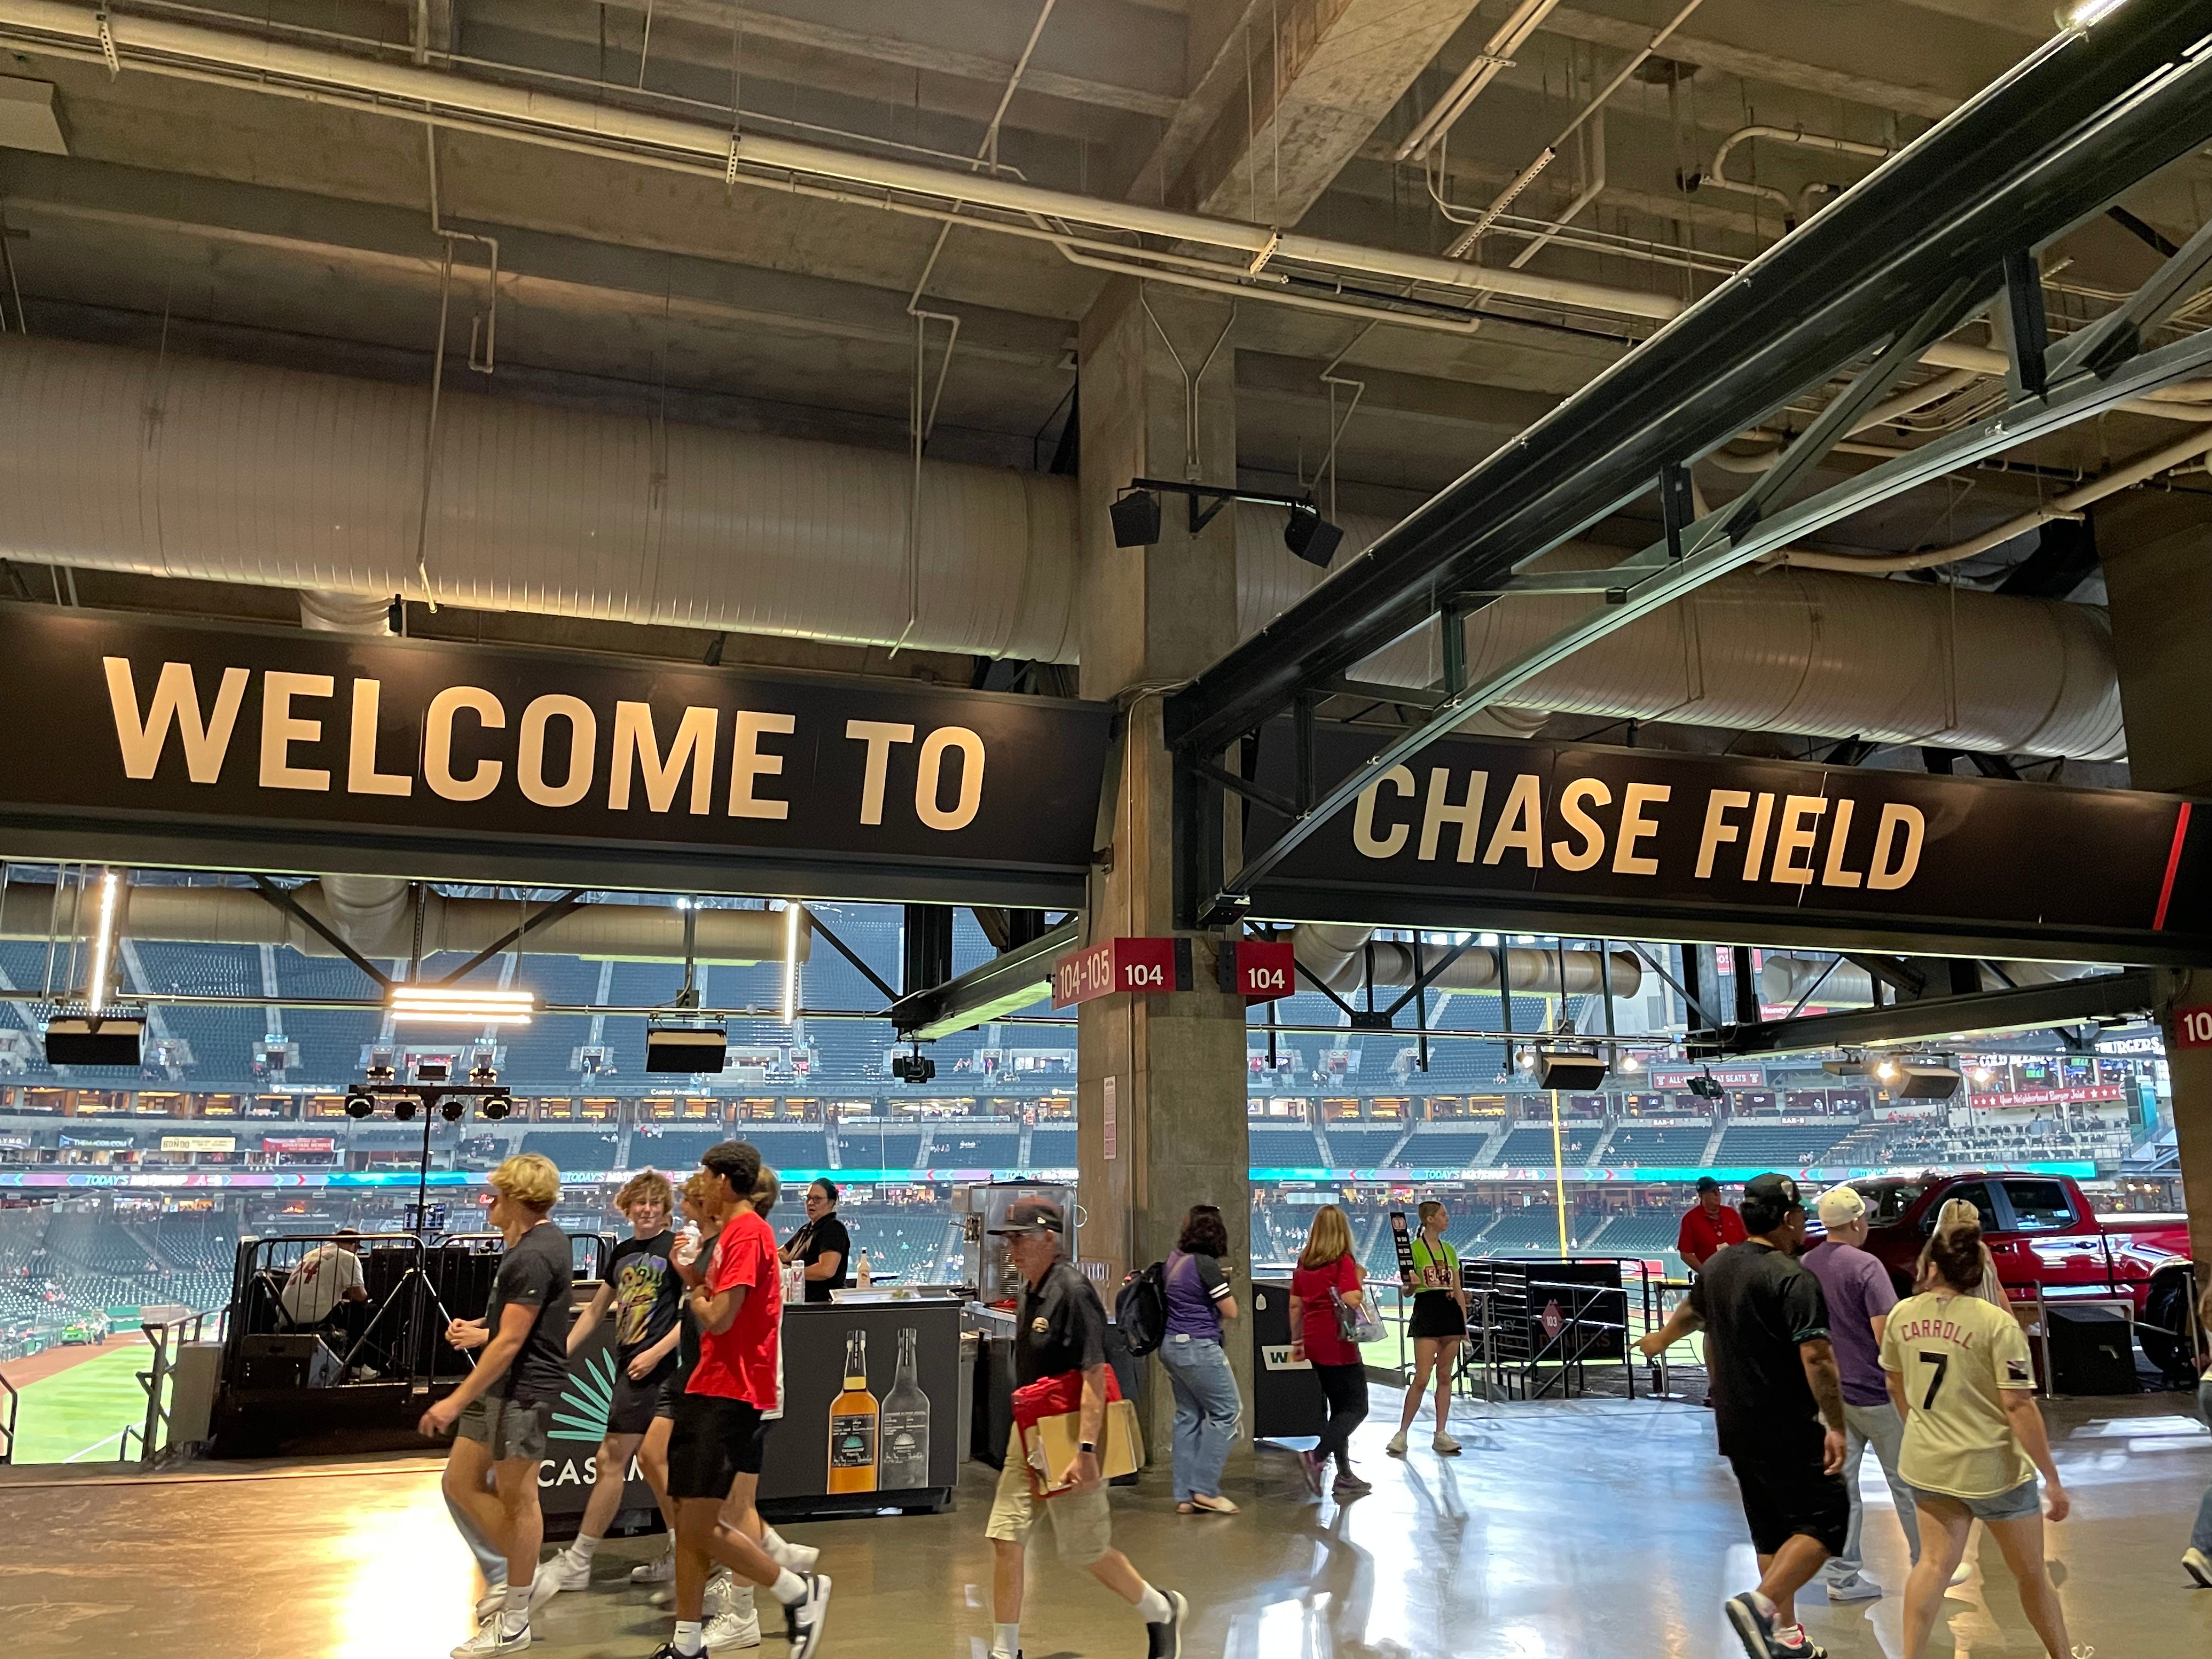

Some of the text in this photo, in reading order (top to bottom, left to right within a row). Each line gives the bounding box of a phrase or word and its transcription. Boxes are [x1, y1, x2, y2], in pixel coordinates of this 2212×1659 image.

[103, 657, 985, 831] WELCOME TO
[1353, 764, 1925, 890] CHASE FIELD
[1060, 949, 1109, 1000] 104-105
[1125, 964, 1164, 986] 104
[1248, 968, 1285, 989] 104
[2184, 1012, 2212, 1041] 10
[1725, 1074, 1746, 1082] SEATS
[85, 1174, 129, 1186] TODAY'S
[566, 1172, 606, 1183] TODAY'S
[1426, 1169, 1509, 1181] TODAY'S MATCHUP
[1546, 1316, 1558, 1327] 103
[1901, 1319, 1973, 1350] CARROLL
[1919, 1351, 1948, 1410] 7
